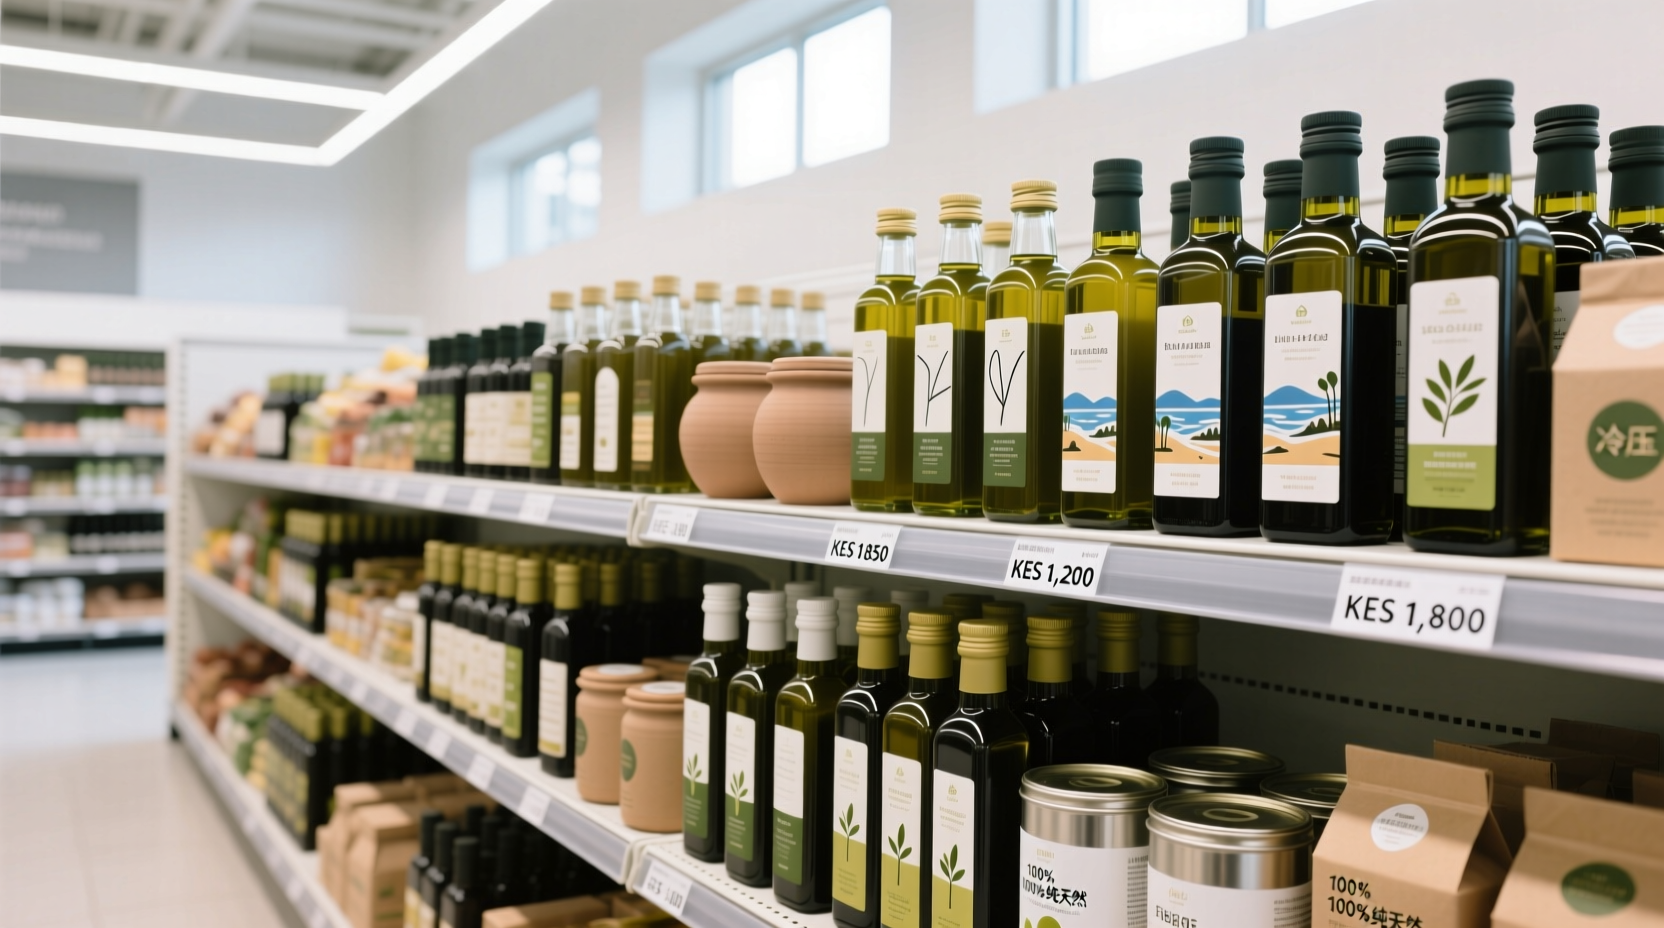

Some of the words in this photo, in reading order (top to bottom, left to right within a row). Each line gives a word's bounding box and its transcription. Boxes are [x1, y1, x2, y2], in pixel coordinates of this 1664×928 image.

[1595, 423, 1659, 457] 冷压
[831, 539, 855, 558] KES
[858, 543, 889, 562] 1850
[1011, 559, 1043, 580] KES
[1047, 563, 1094, 588] 1,200
[1345, 595, 1395, 623] KES
[1406, 602, 1485, 634] 1,800
[1329, 875, 1371, 899] 100%
